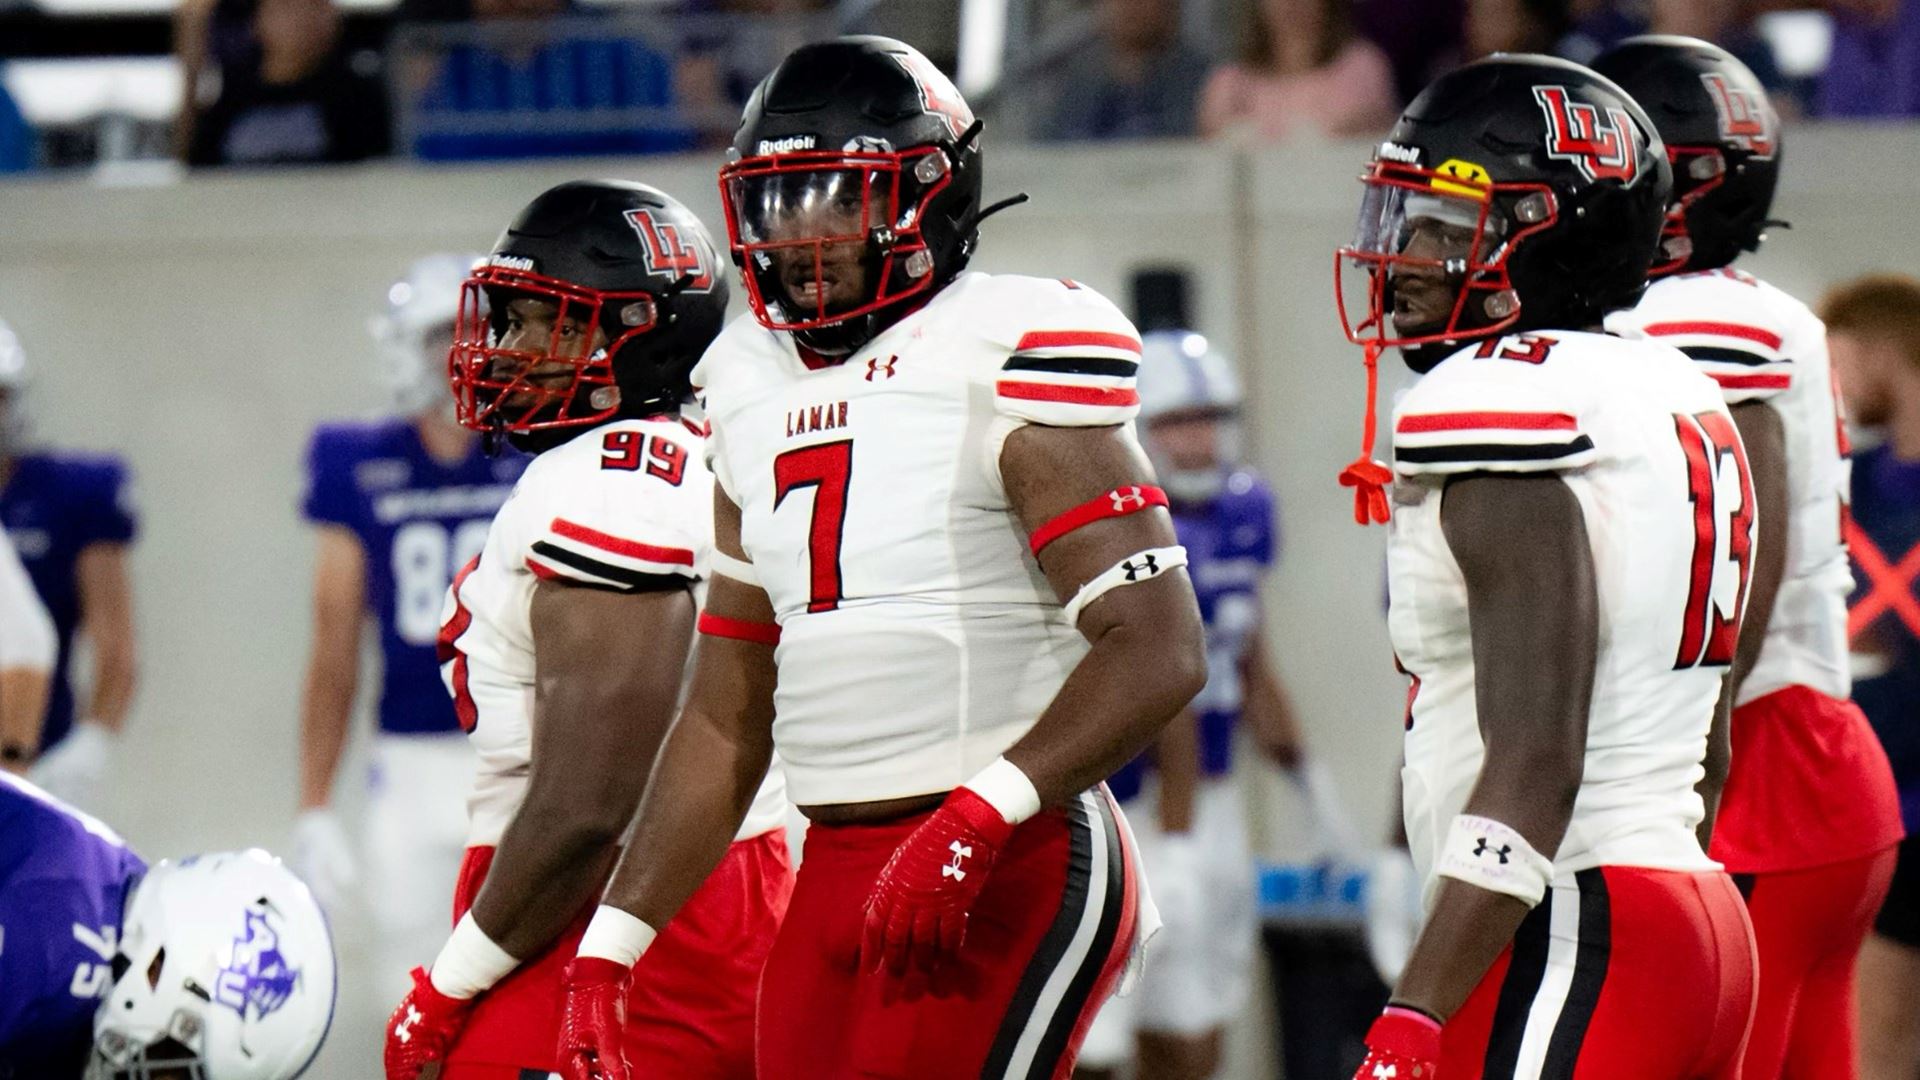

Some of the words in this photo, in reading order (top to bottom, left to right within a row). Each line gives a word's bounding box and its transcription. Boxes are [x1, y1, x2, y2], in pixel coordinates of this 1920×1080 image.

[759, 135, 815, 155] Riddell
[1381, 142, 1420, 162] dell
[1532, 85, 1639, 189] LU
[787, 401, 848, 438] LAMAR
[601, 431, 688, 487] 99
[773, 438, 854, 614] 7
[1672, 410, 1753, 670] 13
[70, 922, 117, 998] 75
